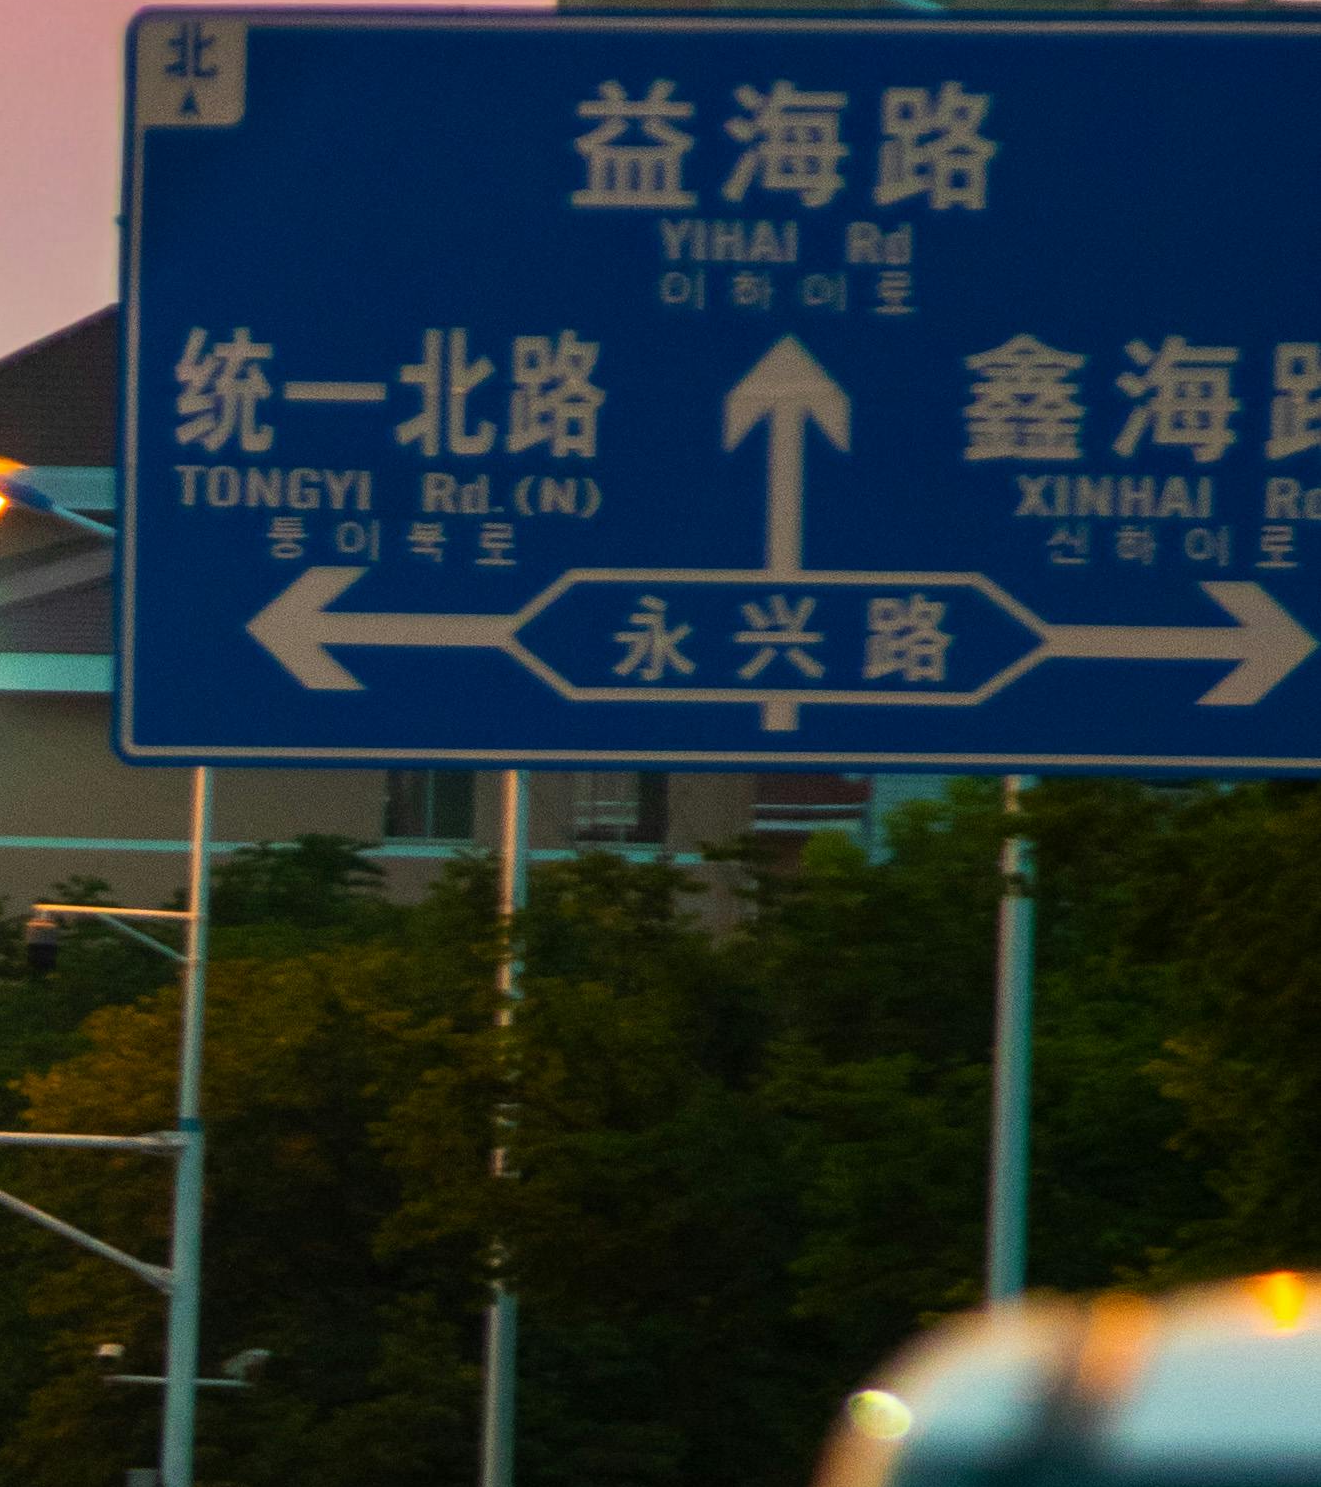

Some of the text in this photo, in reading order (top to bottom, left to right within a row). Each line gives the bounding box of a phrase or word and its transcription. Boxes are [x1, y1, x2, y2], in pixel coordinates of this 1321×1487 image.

[164, 20, 219, 79] 北
[571, 80, 996, 210] 益海路
[660, 219, 913, 266] YIHAI Rd
[175, 327, 605, 458] 统一北路
[176, 465, 372, 511] TONGYI
[1015, 475, 1212, 518] XINHAI
[612, 593, 952, 682] 永兴路
